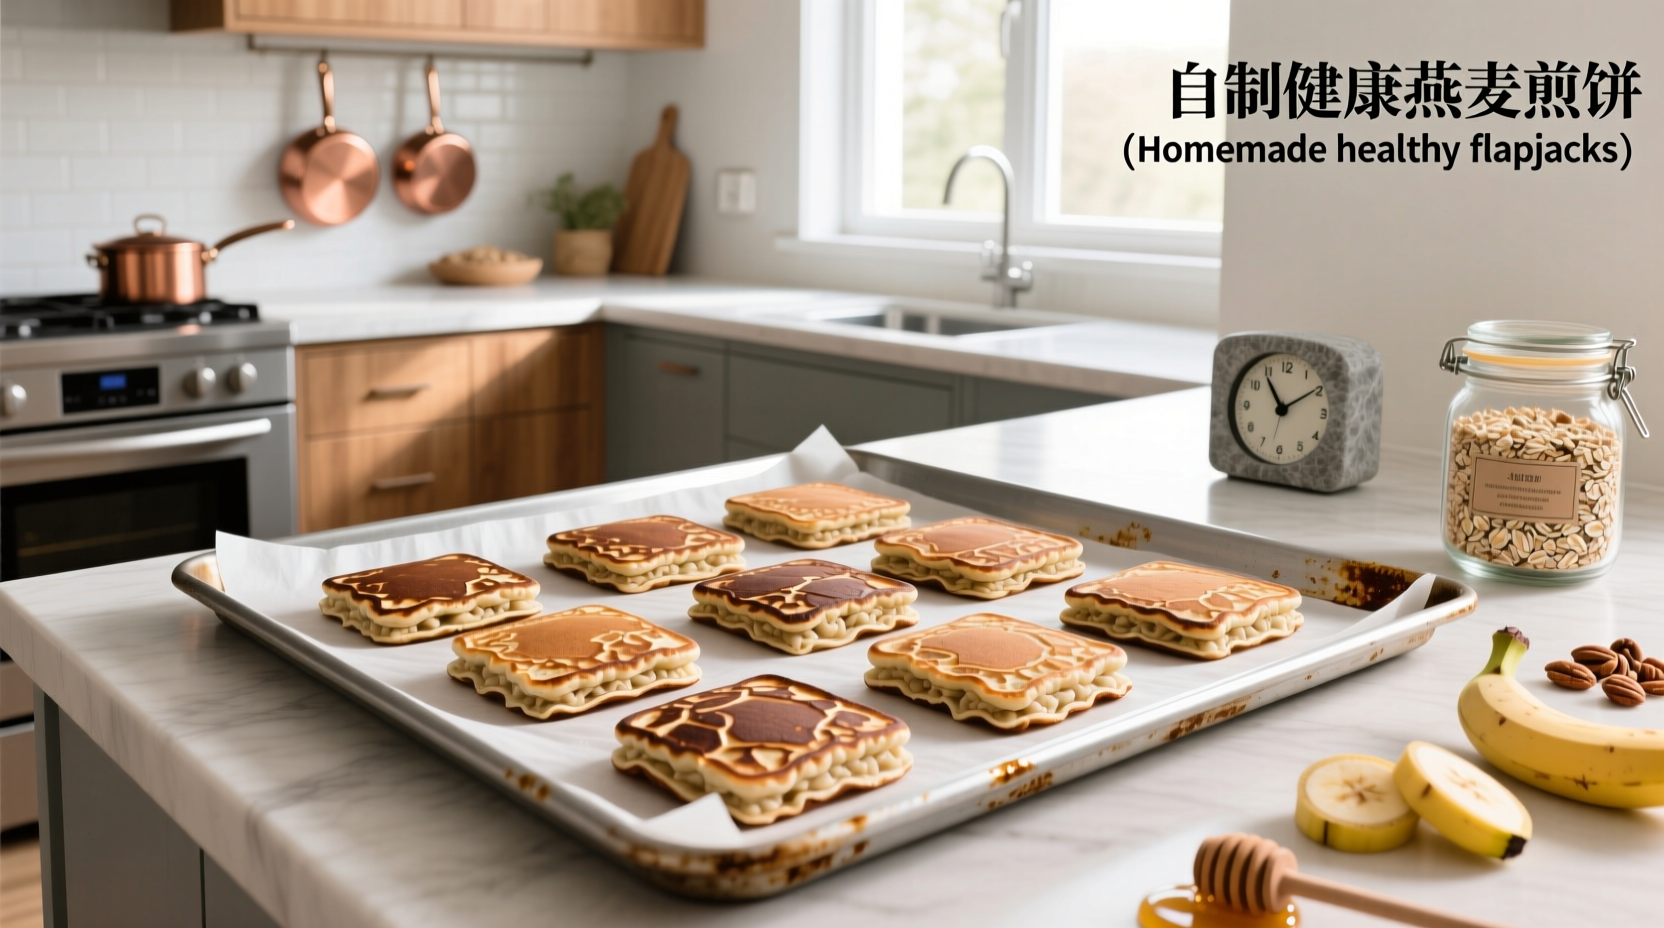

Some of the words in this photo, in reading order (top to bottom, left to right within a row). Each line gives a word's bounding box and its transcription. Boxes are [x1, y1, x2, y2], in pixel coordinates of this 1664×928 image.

[1264, 366, 1273, 377] 11
[1281, 361, 1294, 374] 12
[1250, 379, 1261, 391] 10
[1315, 385, 1324, 397] 2
[1243, 400, 1251, 411] 9
[1319, 408, 1328, 420] 3
[1311, 430, 1320, 441] 4
[1259, 436, 1266, 447] 7
[1296, 440, 1304, 452] 5
[1275, 445, 1283, 455] 6
